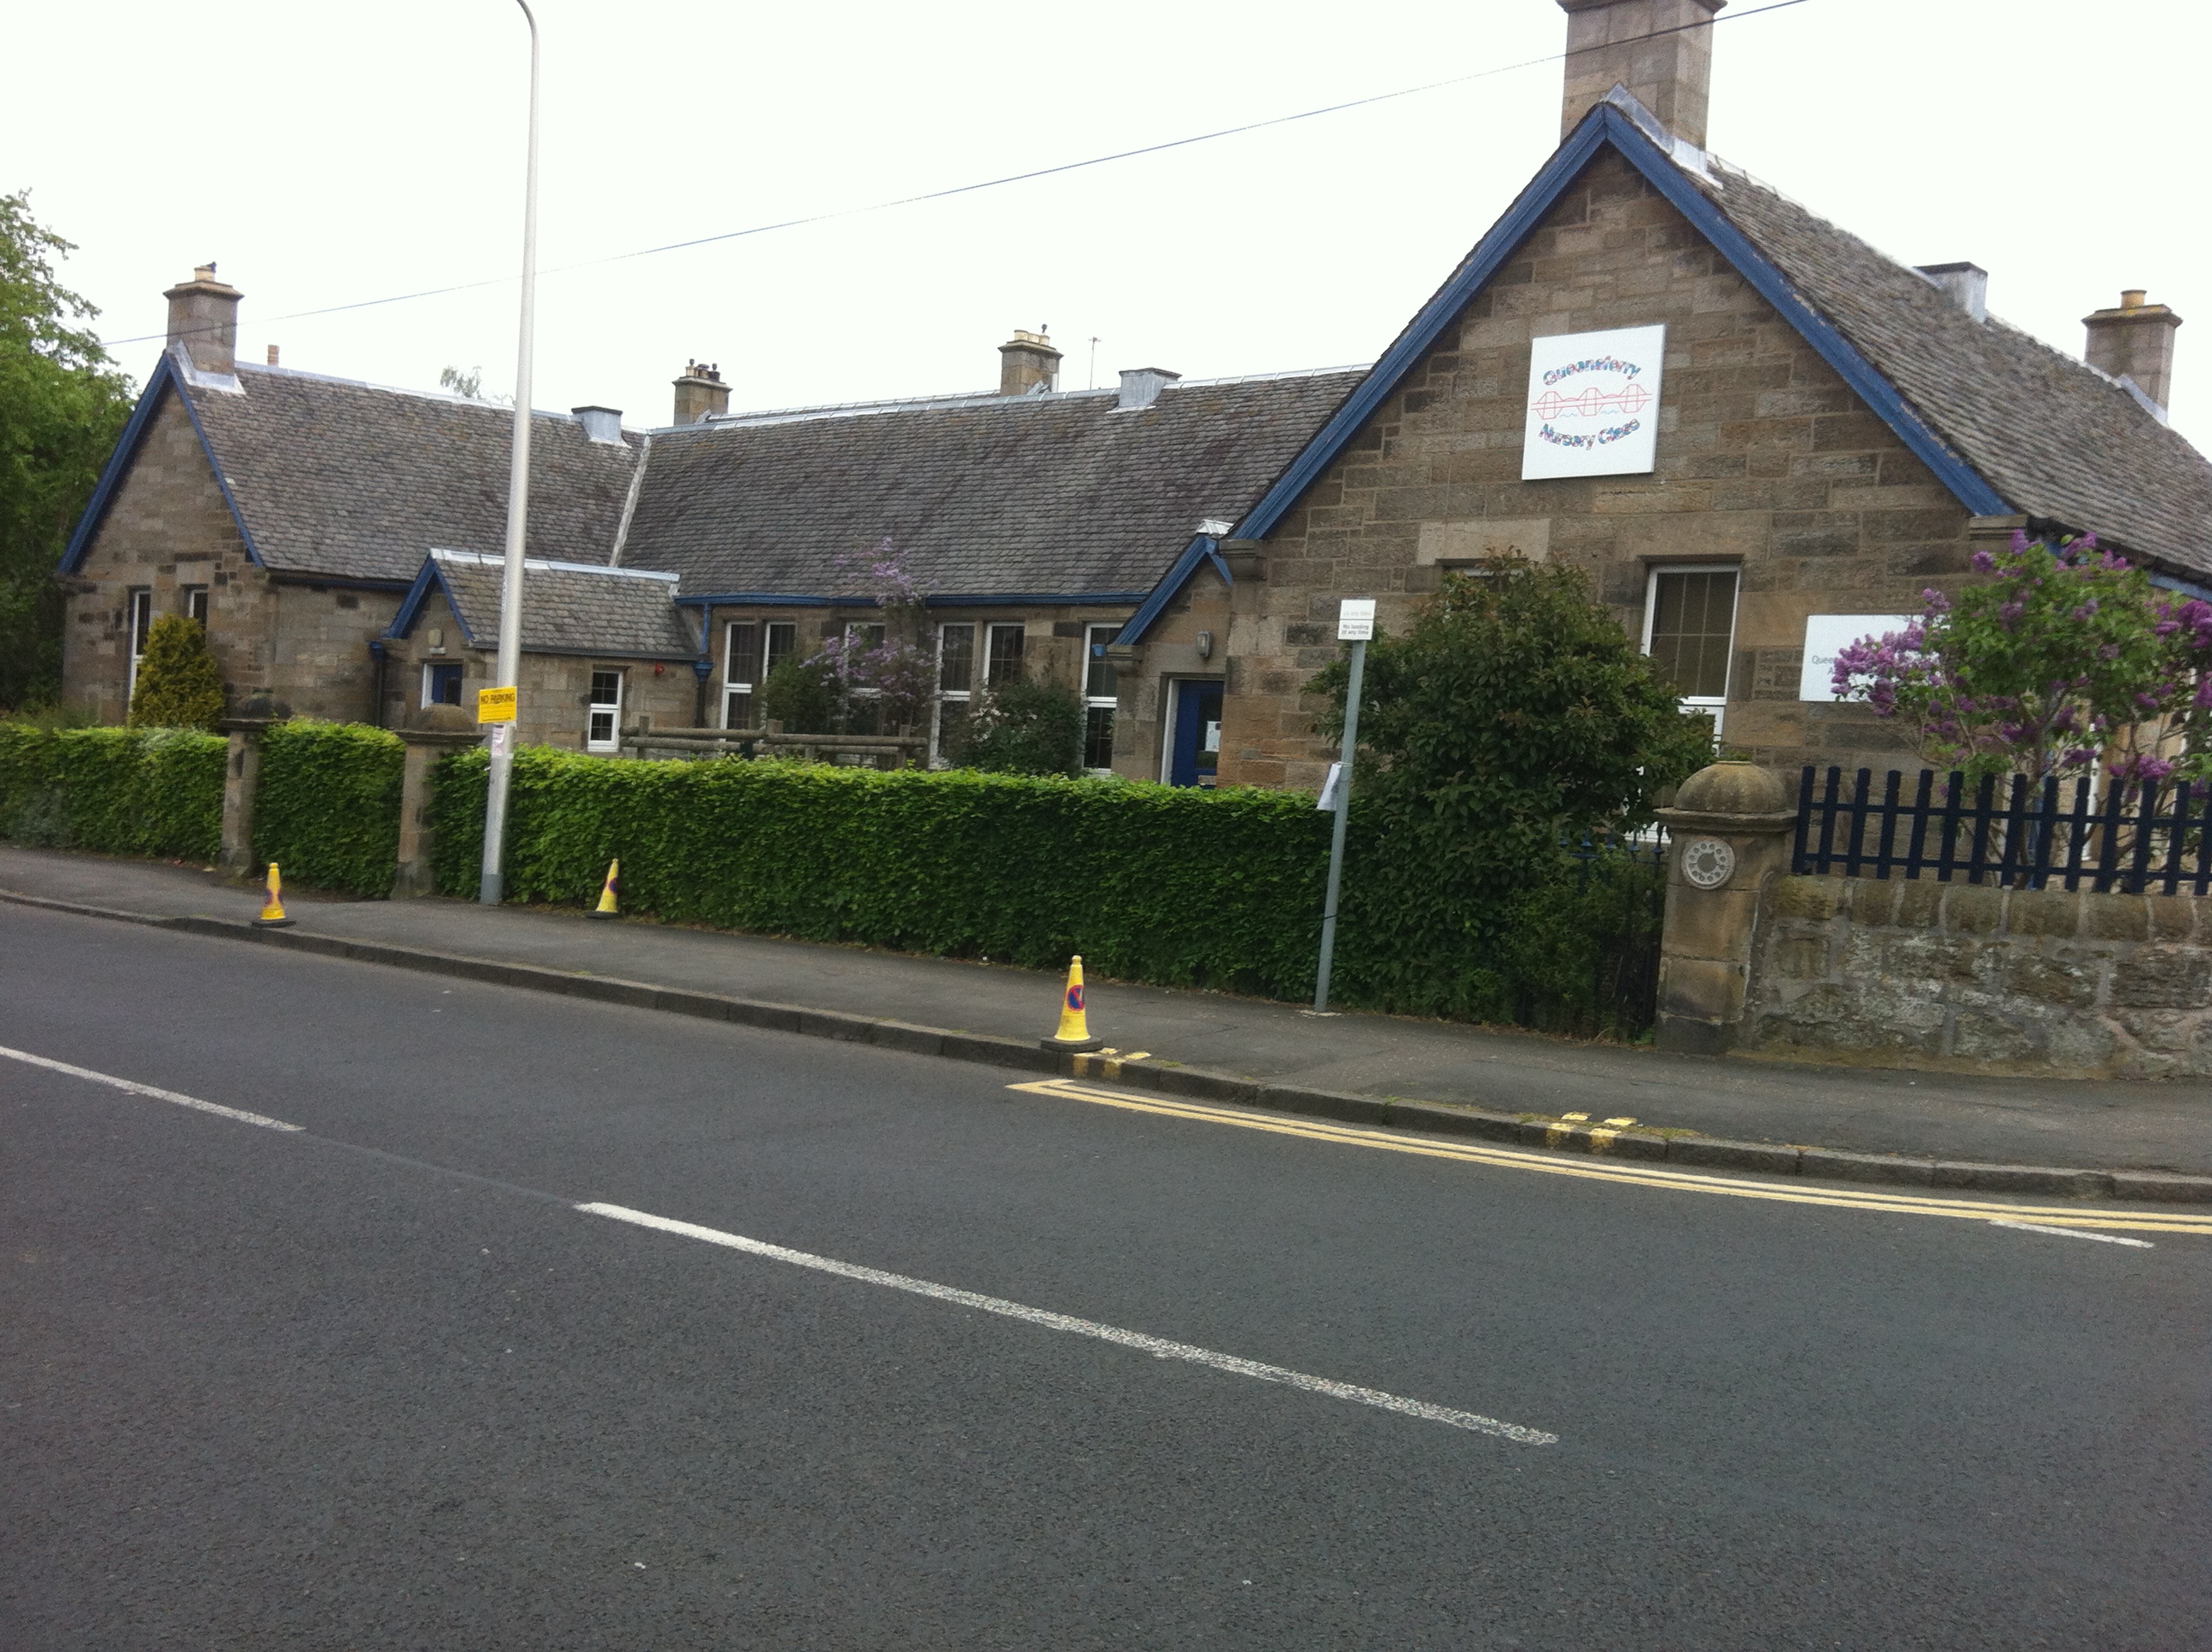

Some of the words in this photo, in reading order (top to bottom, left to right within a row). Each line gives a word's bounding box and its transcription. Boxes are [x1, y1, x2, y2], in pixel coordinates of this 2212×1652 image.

[1543, 355, 1642, 386] Queensferry
[1538, 423, 1596, 451] Nursery
[1598, 418, 1641, 445] Class
[480, 695, 489, 704] NO
[490, 692, 515, 704] PARKING
